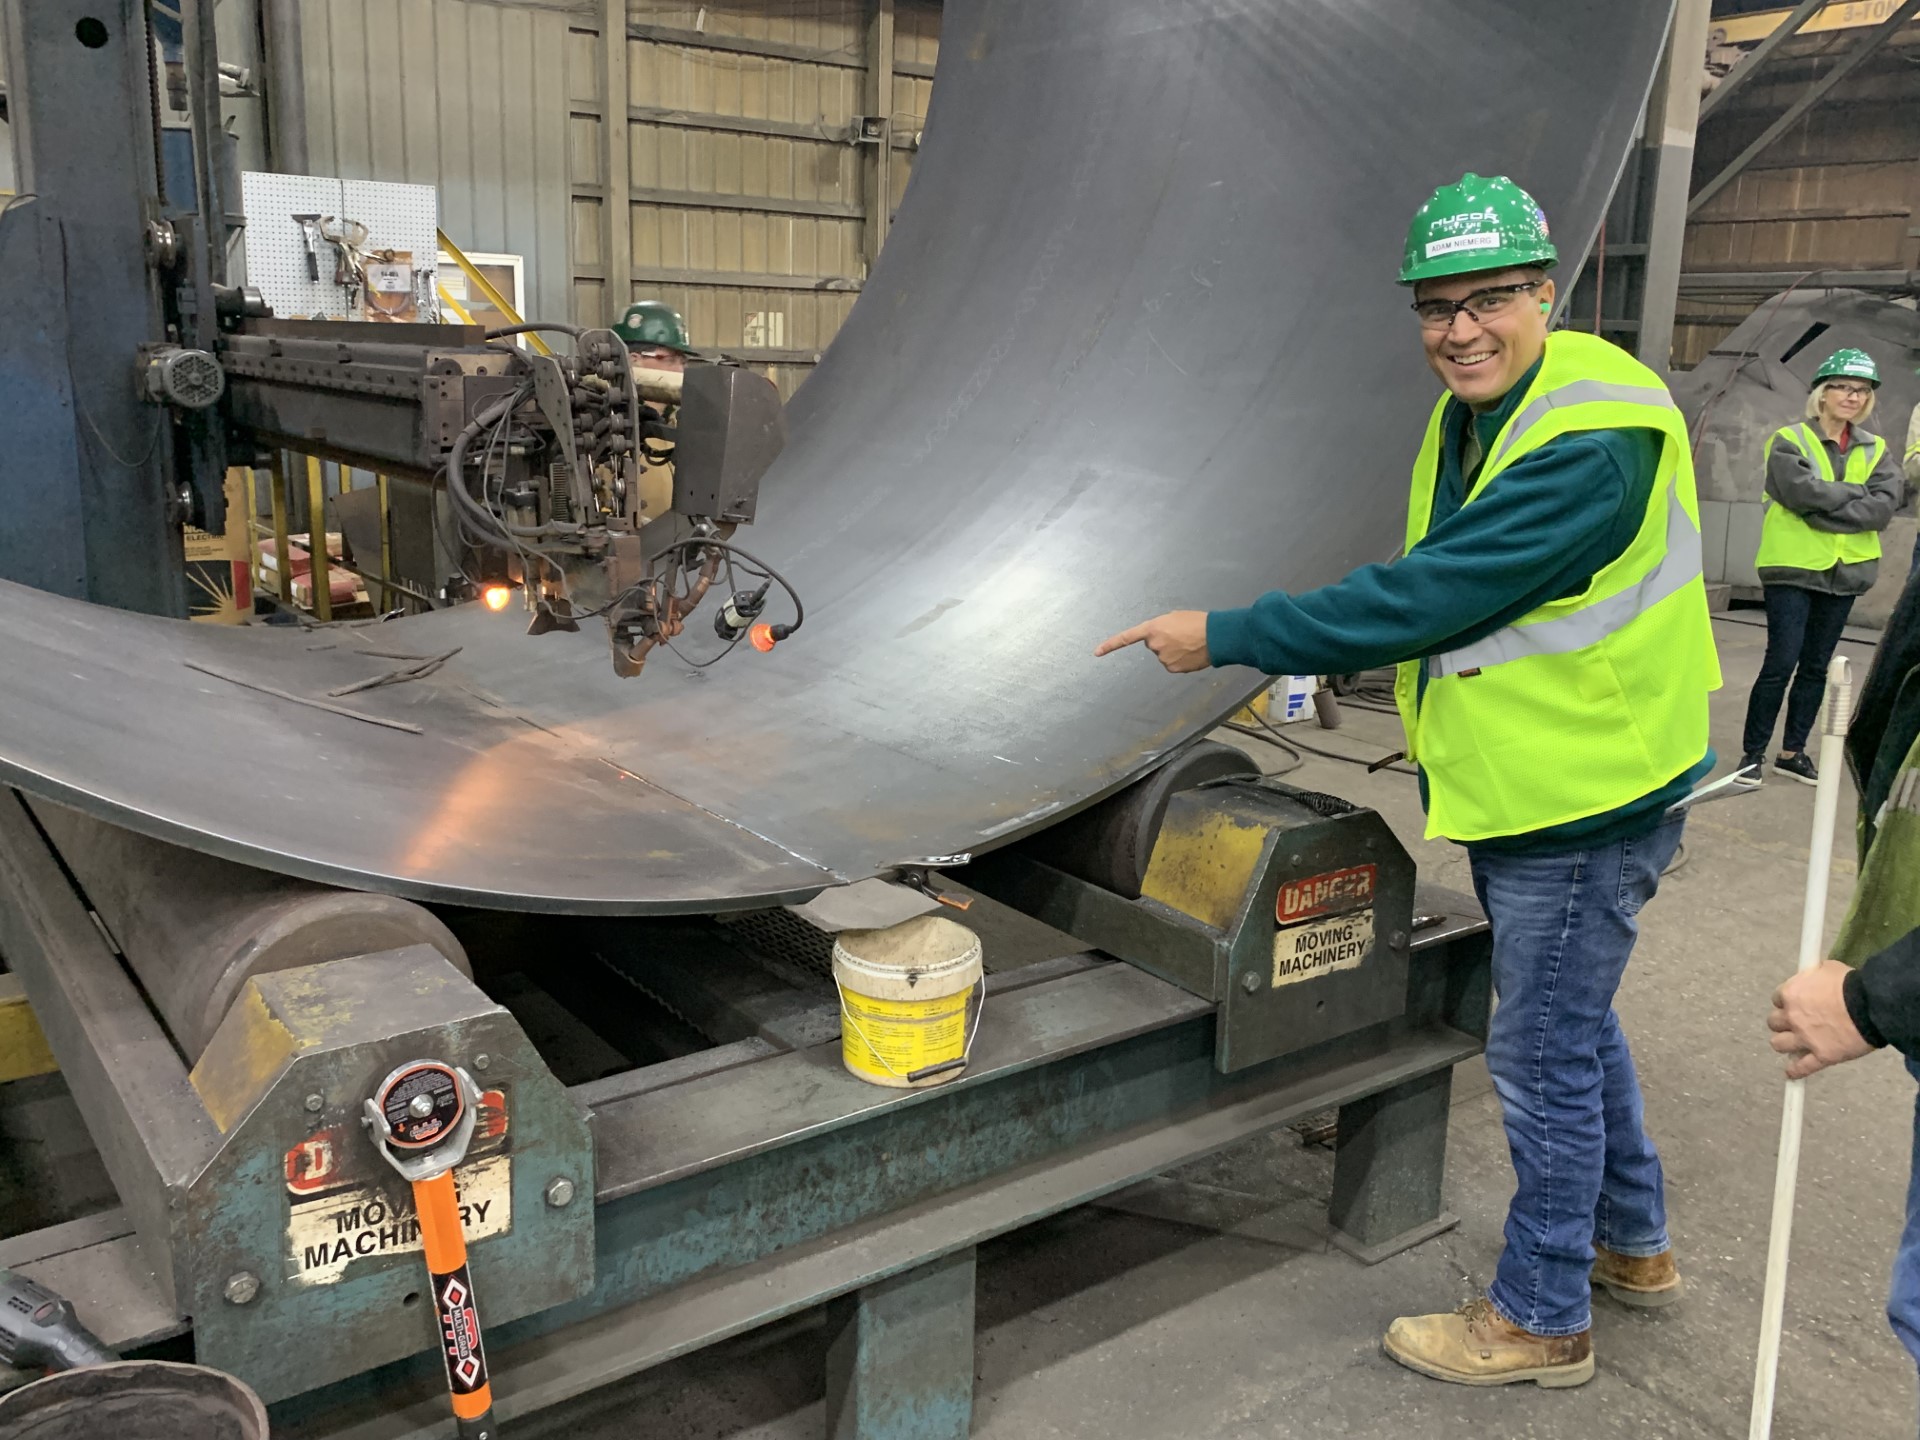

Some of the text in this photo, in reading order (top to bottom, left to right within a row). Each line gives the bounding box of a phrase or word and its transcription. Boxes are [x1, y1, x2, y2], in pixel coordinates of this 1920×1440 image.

[1430, 212, 1500, 230] NUCOR
[1431, 236, 1492, 253] ADAM NIEMERG
[1295, 925, 1353, 954] MOVING
[1279, 939, 1366, 977] MACHINERY
[304, 1200, 492, 1270] MACHINRY
